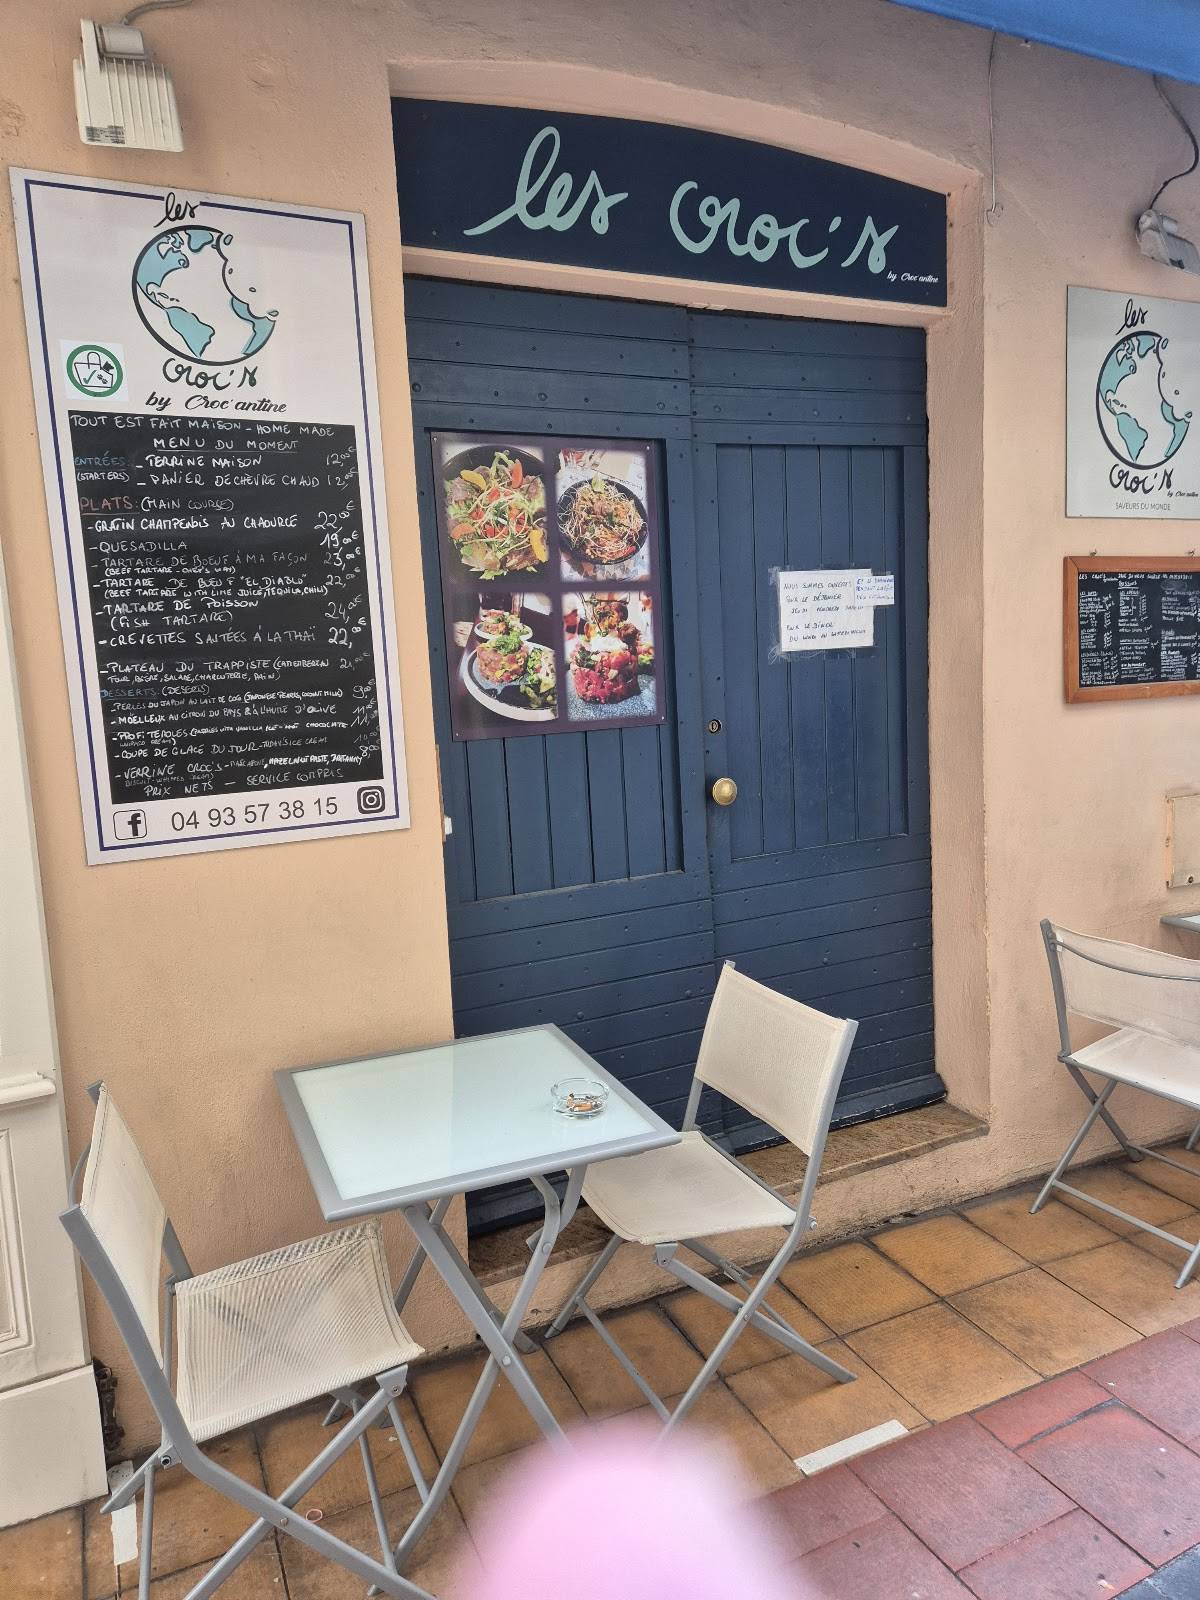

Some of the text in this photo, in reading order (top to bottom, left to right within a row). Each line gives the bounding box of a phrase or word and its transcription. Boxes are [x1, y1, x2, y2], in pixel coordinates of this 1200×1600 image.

[463, 126, 629, 235] les
[154, 192, 199, 227] les
[887, 271, 897, 282] by
[1116, 299, 1148, 335] les
[145, 391, 172, 411] by
[70, 415, 108, 427] TOUT
[114, 416, 144, 428] EST
[256, 424, 291, 435] HOME
[300, 427, 335, 436] MADE
[153, 437, 299, 450] MENU DU MOMENT
[77, 472, 130, 482] (STARTERS)
[282, 475, 320, 486] CHAUD
[1115, 502, 1139, 510] SAVEURS
[1150, 503, 1171, 511] MONDE
[221, 516, 236, 530] AU
[100, 541, 188, 553] QUESADILLA
[101, 556, 164, 568] TARTARE
[170, 556, 188, 567] DE
[246, 553, 265, 564] MA
[100, 577, 155, 588] TARTARE
[164, 578, 188, 590] DE
[136, 589, 177, 597] TARTARE
[103, 601, 165, 615] TARTARE
[173, 599, 191, 611] DE
[110, 632, 186, 647] CREVETTES
[267, 631, 282, 642] LA
[106, 662, 164, 673] PLATEAU
[176, 661, 194, 673] DU
[121, 749, 149, 760] COUPE
[154, 748, 169, 757] DE
[172, 744, 205, 756] GLACE
[211, 745, 225, 754] DU
[184, 781, 214, 794] NETS
[247, 772, 291, 786] SERVICE
[171, 796, 339, 831] 04 93 57 38 15
